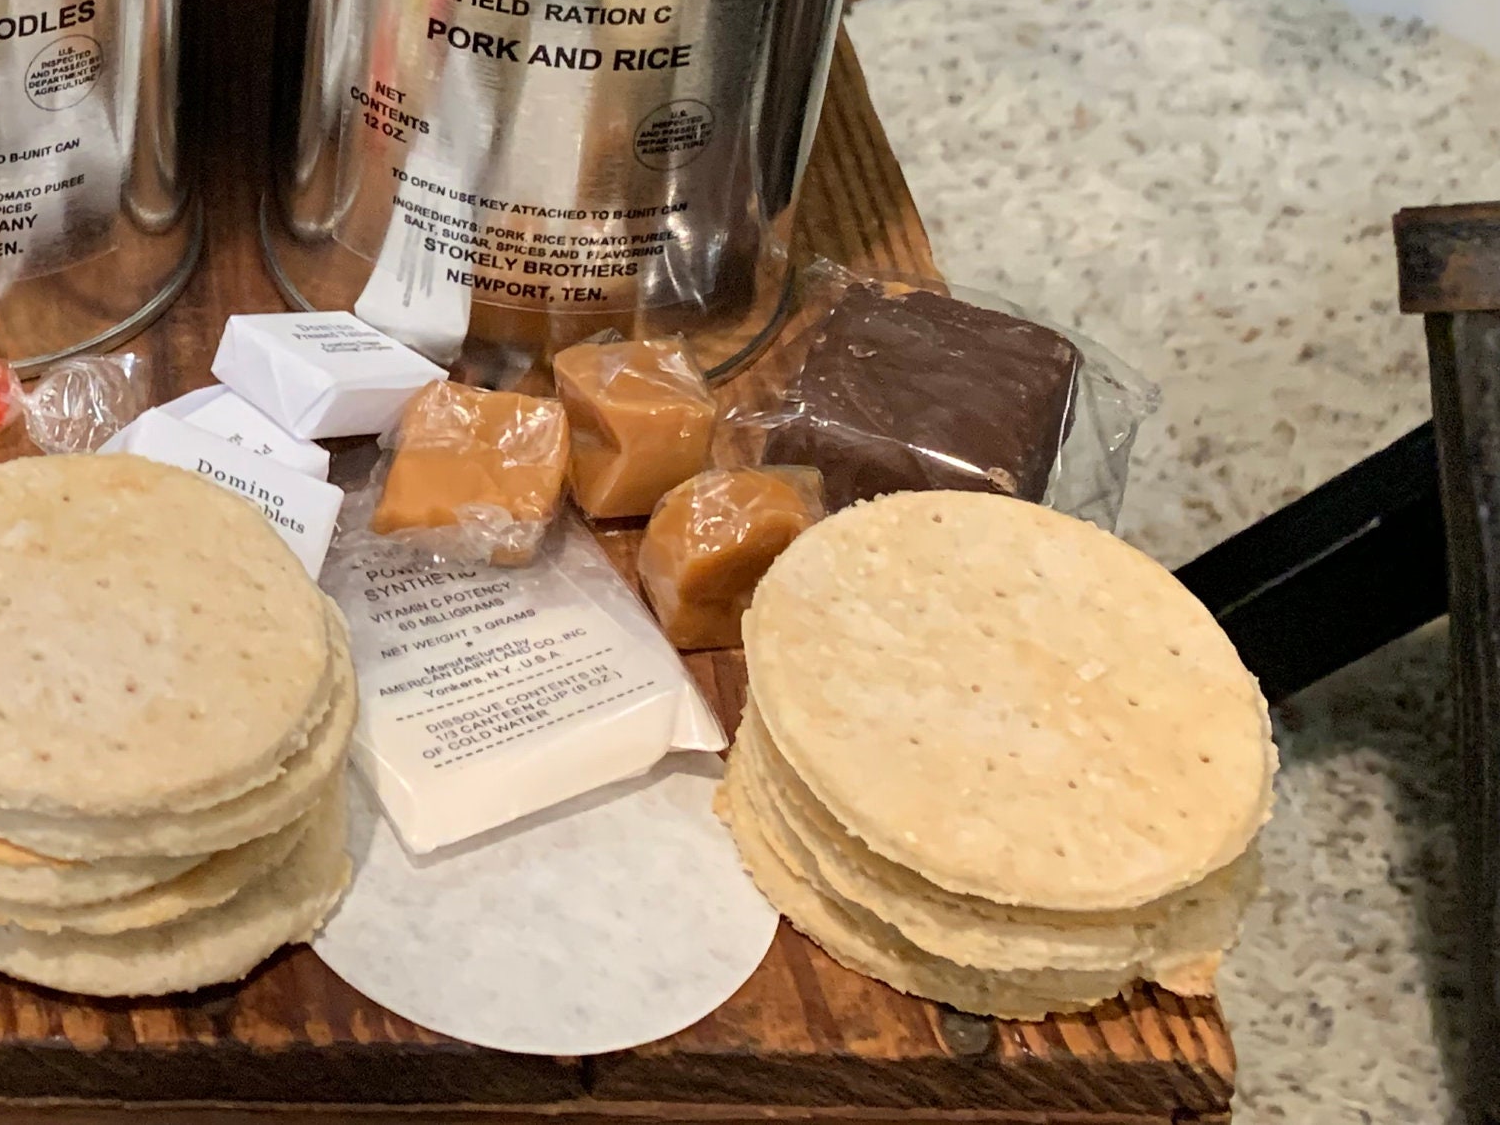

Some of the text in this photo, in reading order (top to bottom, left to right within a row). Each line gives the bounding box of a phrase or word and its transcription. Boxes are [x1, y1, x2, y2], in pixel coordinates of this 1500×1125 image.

[544, 4, 646, 25] RATION
[654, 6, 672, 24] C
[427, 19, 692, 71] PORK AND RICE
[350, 86, 430, 134] CONTENTS
[374, 81, 406, 104] NET
[363, 113, 380, 129] 12
[9, 146, 52, 163] B-UNIT
[55, 138, 80, 155] CAN
[424, 237, 638, 277] STOKELY BROTHERS
[446, 268, 608, 303] NEWPORT, TEN.
[197, 458, 284, 507] Domino
[370, 582, 511, 623] VITAMIN C POTENCY
[419, 598, 504, 626] MILLIGRAMS
[381, 609, 536, 659] NET WEIGHT 3 GRAMS
[450, 709, 549, 750] COLD WATER
[460, 691, 568, 734] CANTEEN CUP
